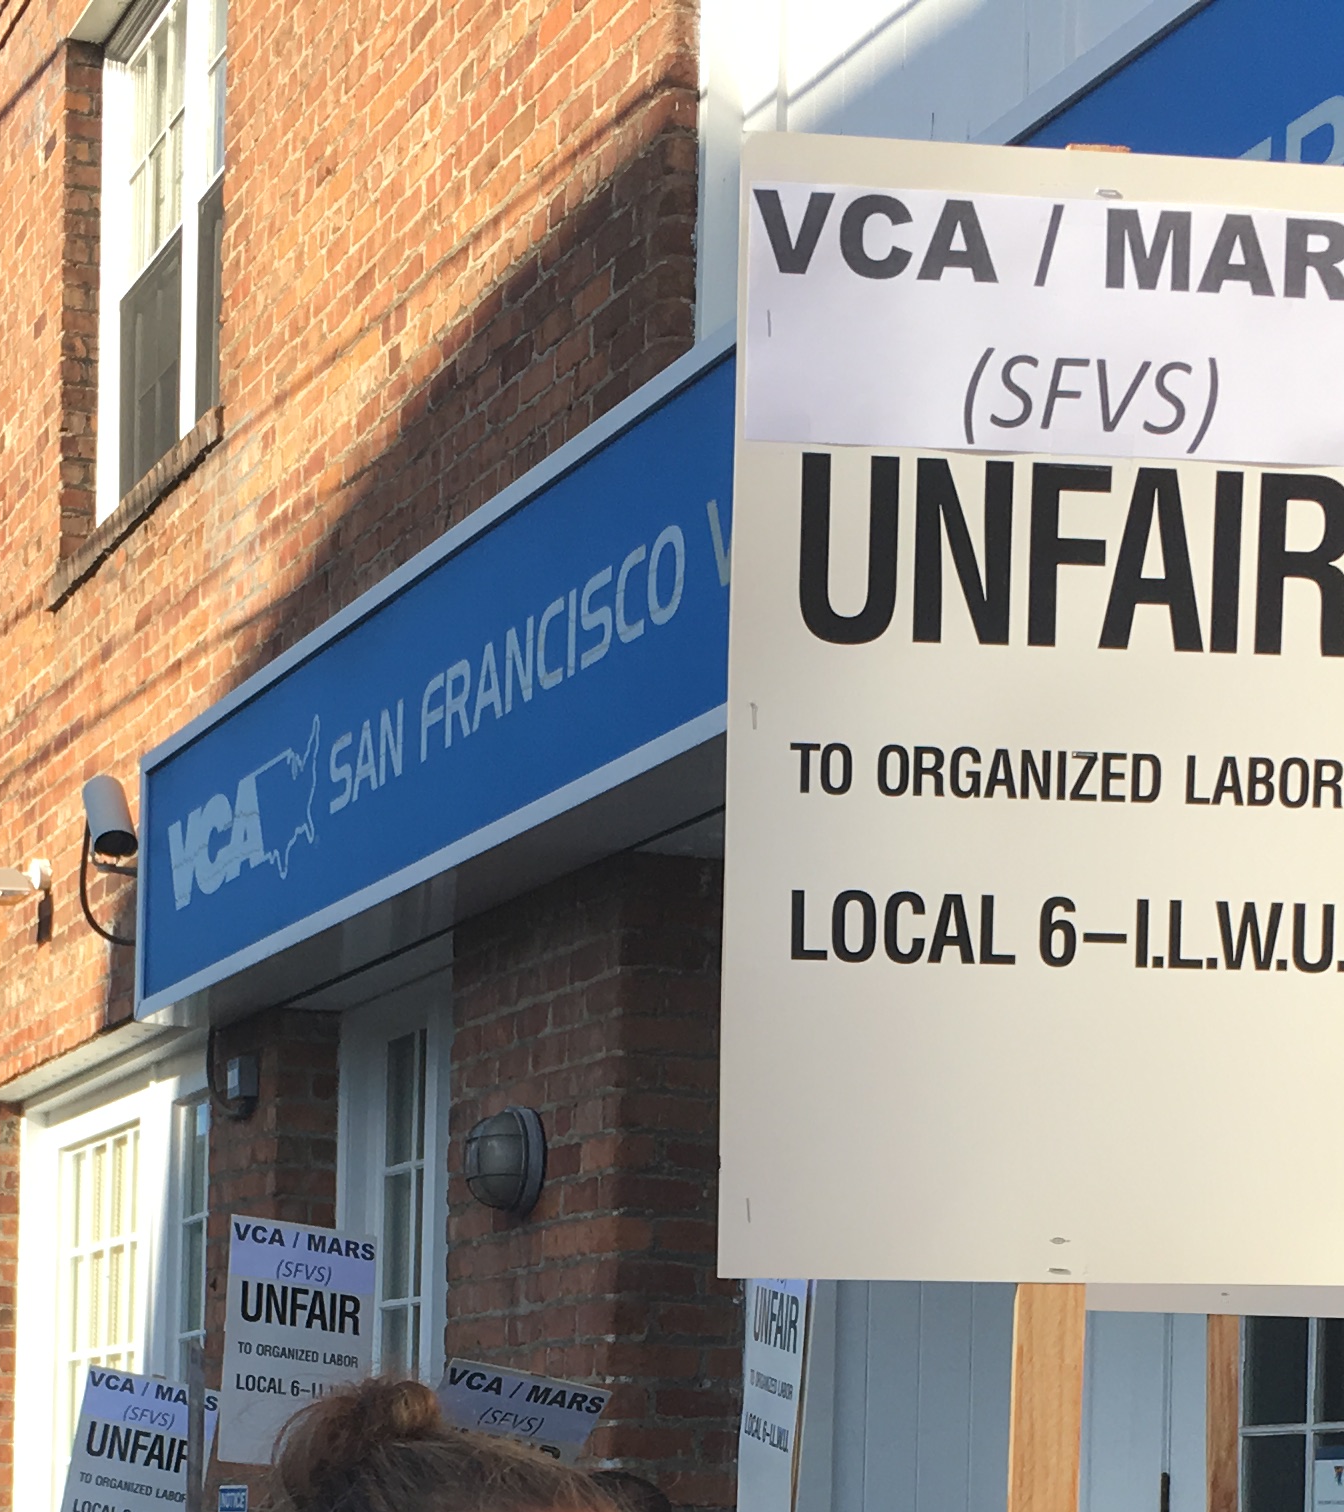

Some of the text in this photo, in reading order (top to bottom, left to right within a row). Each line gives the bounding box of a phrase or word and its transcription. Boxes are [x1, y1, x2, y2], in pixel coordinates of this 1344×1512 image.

[753, 188, 998, 284] VCA
[1034, 204, 1065, 288] /
[963, 347, 1219, 454] (SFVS)
[167, 774, 273, 911] VCA
[329, 699, 405, 814] SAN
[419, 525, 685, 763] FRANCISCO
[790, 742, 1344, 809] TO ORGANIZED LABOR
[790, 889, 1016, 966] LOCAL
[234, 1222, 285, 1247] VCA
[307, 1233, 375, 1261] MARS
[276, 1259, 332, 1287] (SFVS)
[241, 1280, 360, 1336] UNFAIR
[753, 1285, 799, 1354] UNFAIR
[238, 1341, 358, 1368] TO ORGANIZED LABOR
[90, 1371, 134, 1394] VCA
[155, 1384, 218, 1411] MAS
[236, 1373, 286, 1395] LOCAL
[449, 1367, 502, 1395] VCA
[525, 1385, 605, 1414] MARS
[123, 1405, 175, 1430] (SFVS)
[477, 1407, 544, 1437] (SFVS)
[744, 1411, 761, 1440] LOCAL
[79, 1472, 92, 1484] TO
[95, 1475, 153, 1497] ORGANIZED
